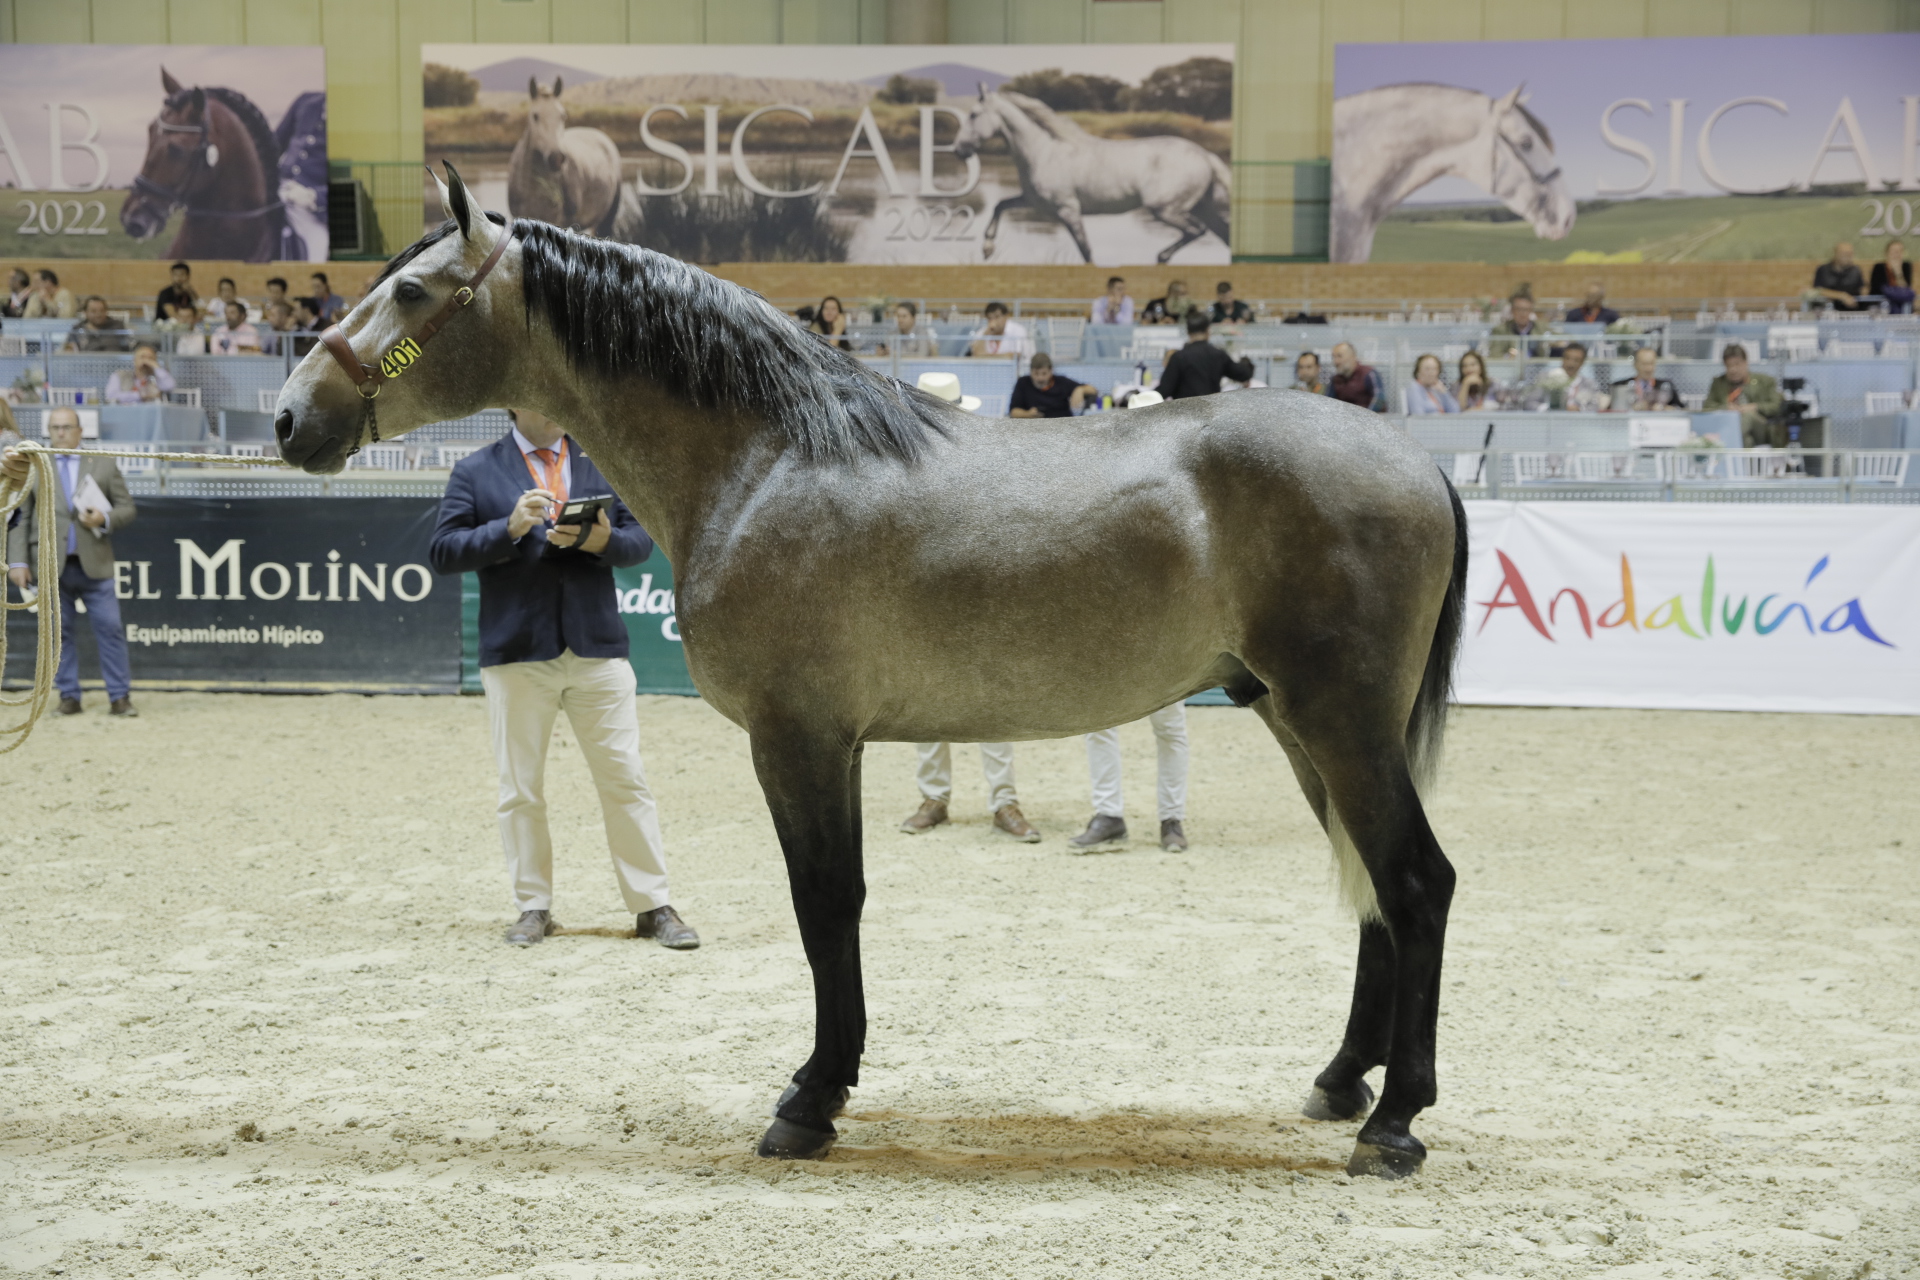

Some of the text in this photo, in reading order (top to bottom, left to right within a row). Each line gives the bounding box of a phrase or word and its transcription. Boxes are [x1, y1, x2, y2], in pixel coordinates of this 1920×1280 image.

[637, 103, 982, 198] SICAB
[16, 199, 109, 235] 2022
[885, 206, 976, 242] 2022
[382, 338, 422, 376] 401
[114, 561, 161, 599] EL
[1475, 547, 1899, 649] Andalucía
[126, 623, 324, 648] Equipamiento Hípico
